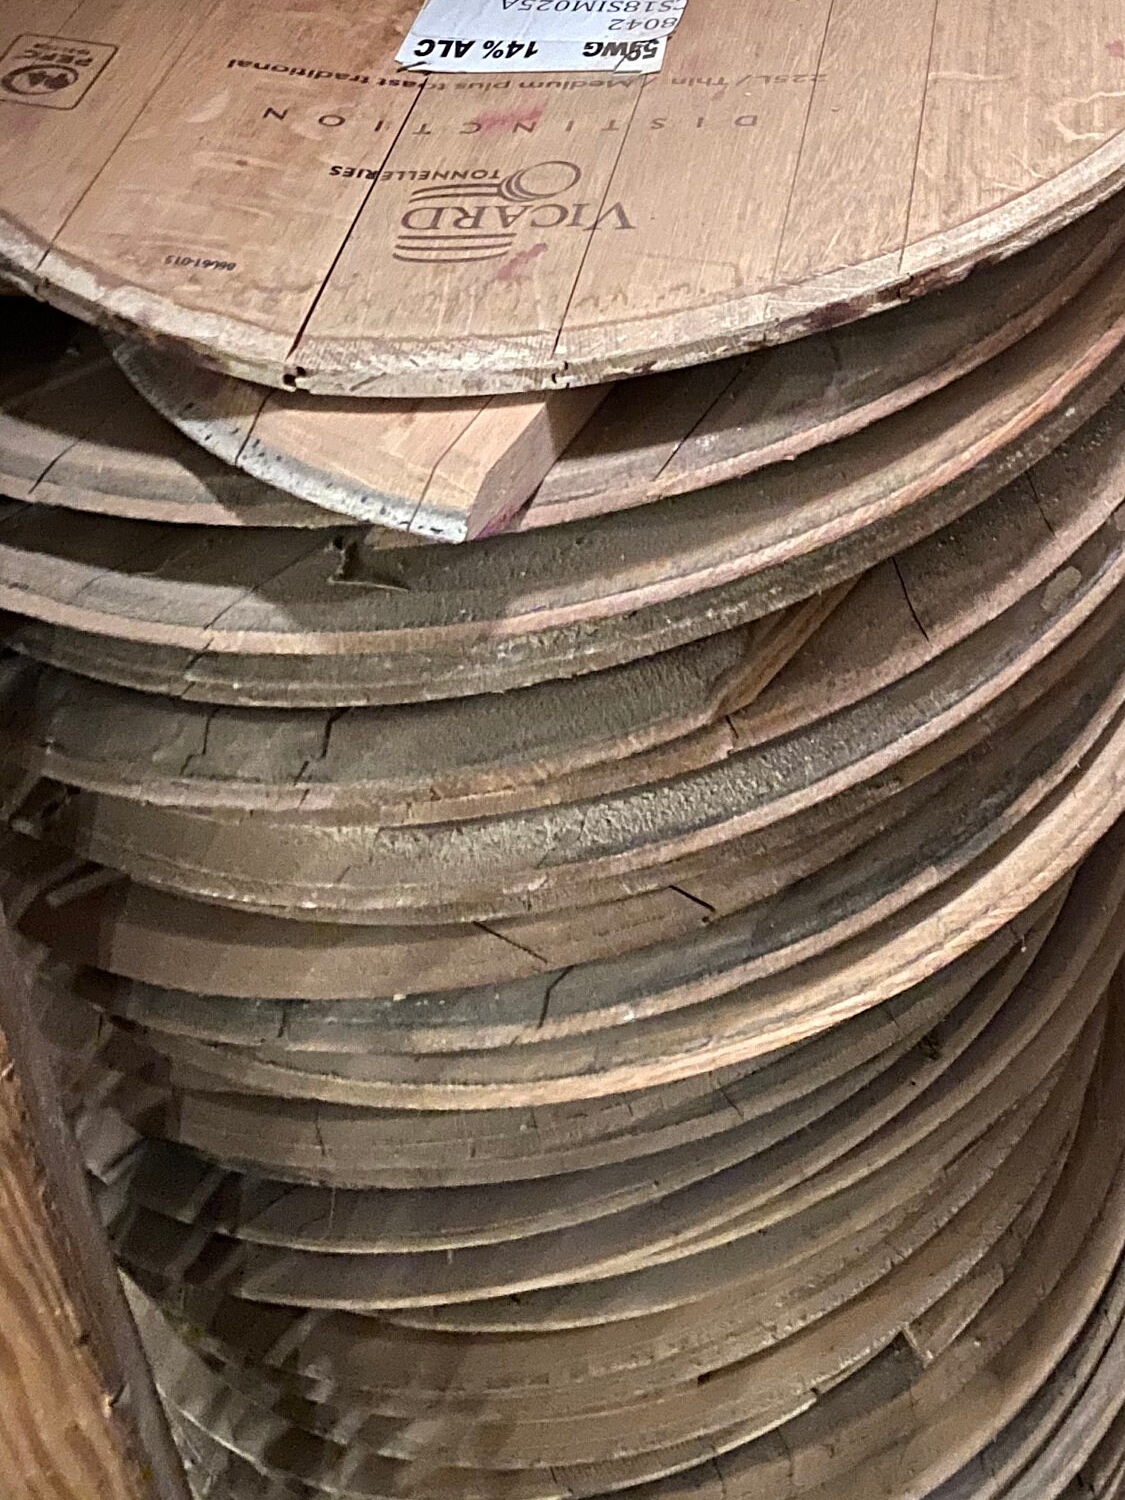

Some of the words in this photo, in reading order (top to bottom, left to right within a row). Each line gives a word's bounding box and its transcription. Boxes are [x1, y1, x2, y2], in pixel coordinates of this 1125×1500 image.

[415, 40, 475, 58] ALC
[483, 41, 539, 59] 14%
[226, 59, 370, 85] traditional
[373, 77, 446, 91] toast
[450, 76, 511, 92] plus
[518, 80, 634, 92] Medium
[671, 78, 730, 88] Thin
[262, 107, 760, 136] DISTINCTION
[328, 165, 500, 182] TONNELLERIES
[400, 202, 637, 232] VICARD
